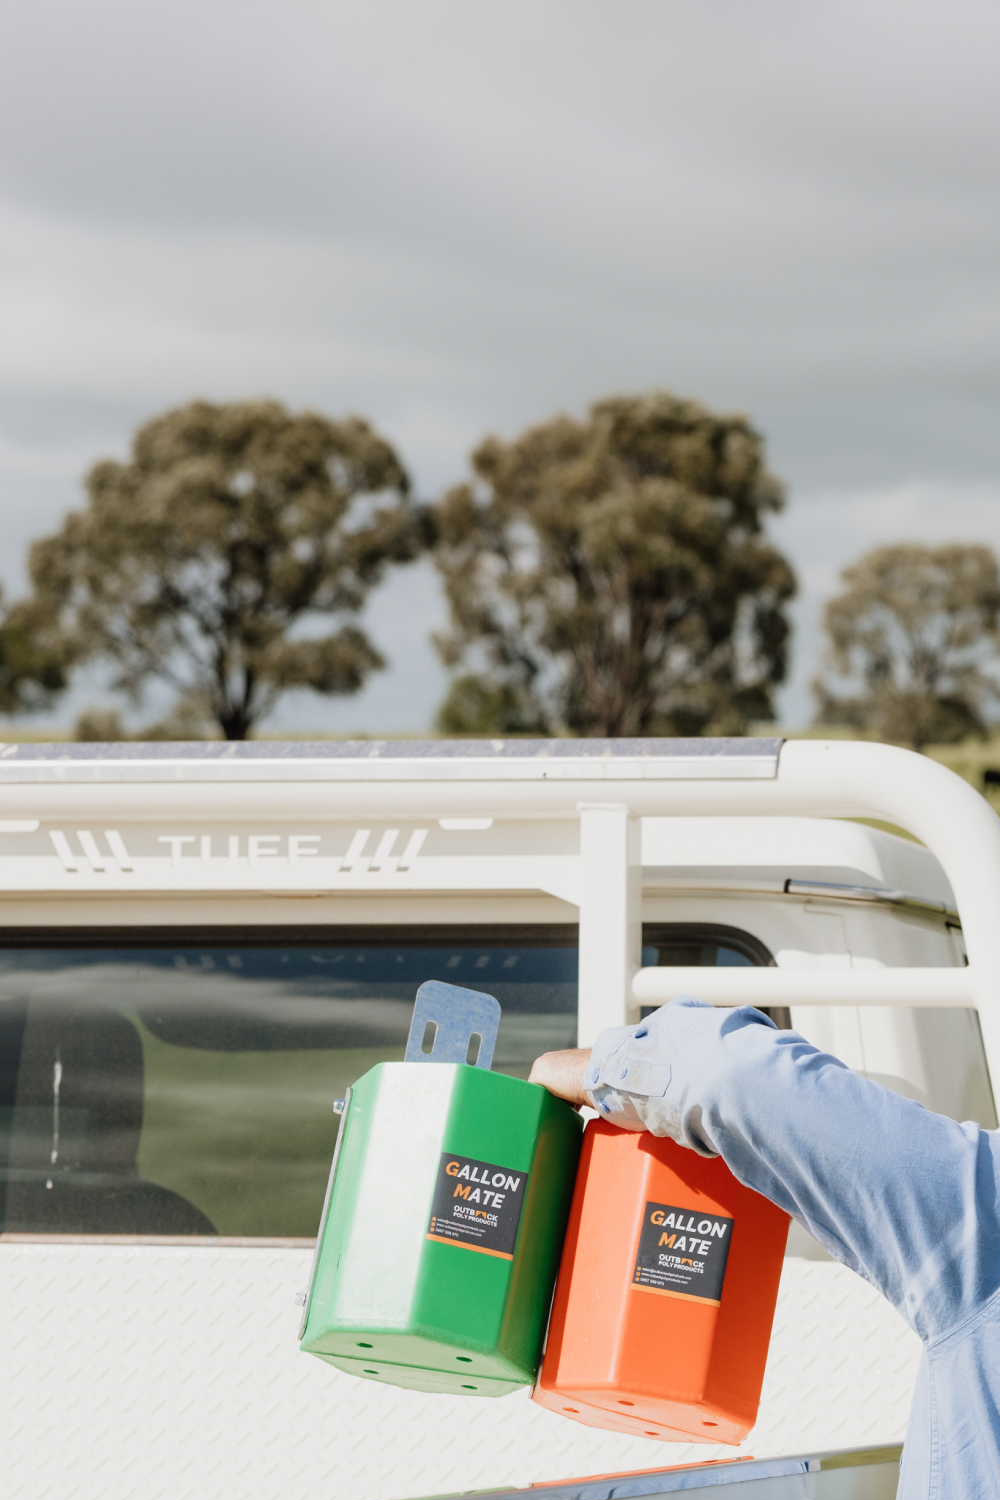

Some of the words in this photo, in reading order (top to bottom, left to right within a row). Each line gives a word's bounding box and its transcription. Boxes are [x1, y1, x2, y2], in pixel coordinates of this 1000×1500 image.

[158, 835, 322, 869] TUFF
[445, 1161, 520, 1192] GALLON
[453, 1183, 506, 1209] MATE
[453, 1212, 468, 1220] POLY
[467, 1215, 498, 1227] PRODUCTS
[650, 1210, 728, 1238] GALLON
[658, 1231, 713, 1256] MATE
[658, 1260, 674, 1268] POLY
[673, 1263, 704, 1274] PRODUCTS
